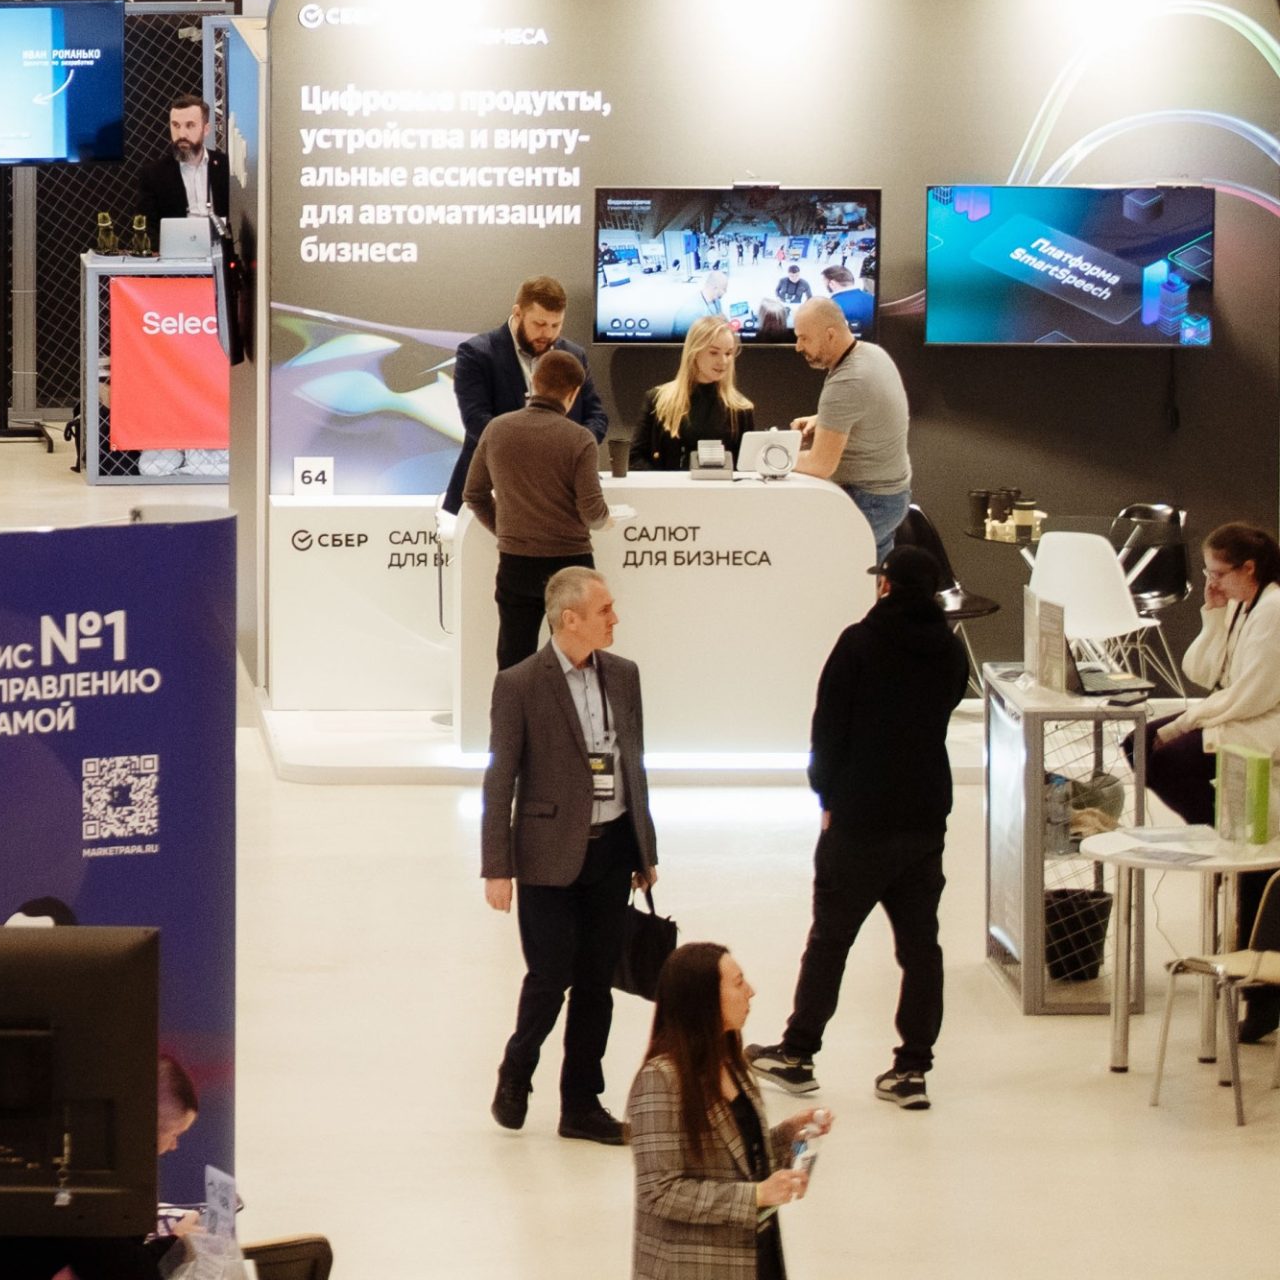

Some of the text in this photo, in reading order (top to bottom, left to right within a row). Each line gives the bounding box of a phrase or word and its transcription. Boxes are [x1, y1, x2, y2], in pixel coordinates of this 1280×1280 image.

[52, 48, 101, 60] РОМАНЬКО
[301, 83, 612, 116] Цифровые продукты,
[300, 122, 590, 154] устройства и вирту-
[300, 165, 581, 188] альные ассистенты
[299, 204, 582, 228] для автоматизации
[300, 235, 418, 263] бизнеса
[1030, 237, 1121, 286] Платформа
[1009, 247, 1112, 301] SmartSpeech
[300, 470, 328, 485] 64
[317, 533, 369, 548] СБЕР
[623, 526, 700, 542] САЛЮТ
[387, 552, 428, 569] ДЛЯ
[623, 550, 772, 568] ДЛЯ БИЗНЕСА
[40, 609, 126, 667] №1
[82, 843, 160, 858] MARKETPAPA.RU
